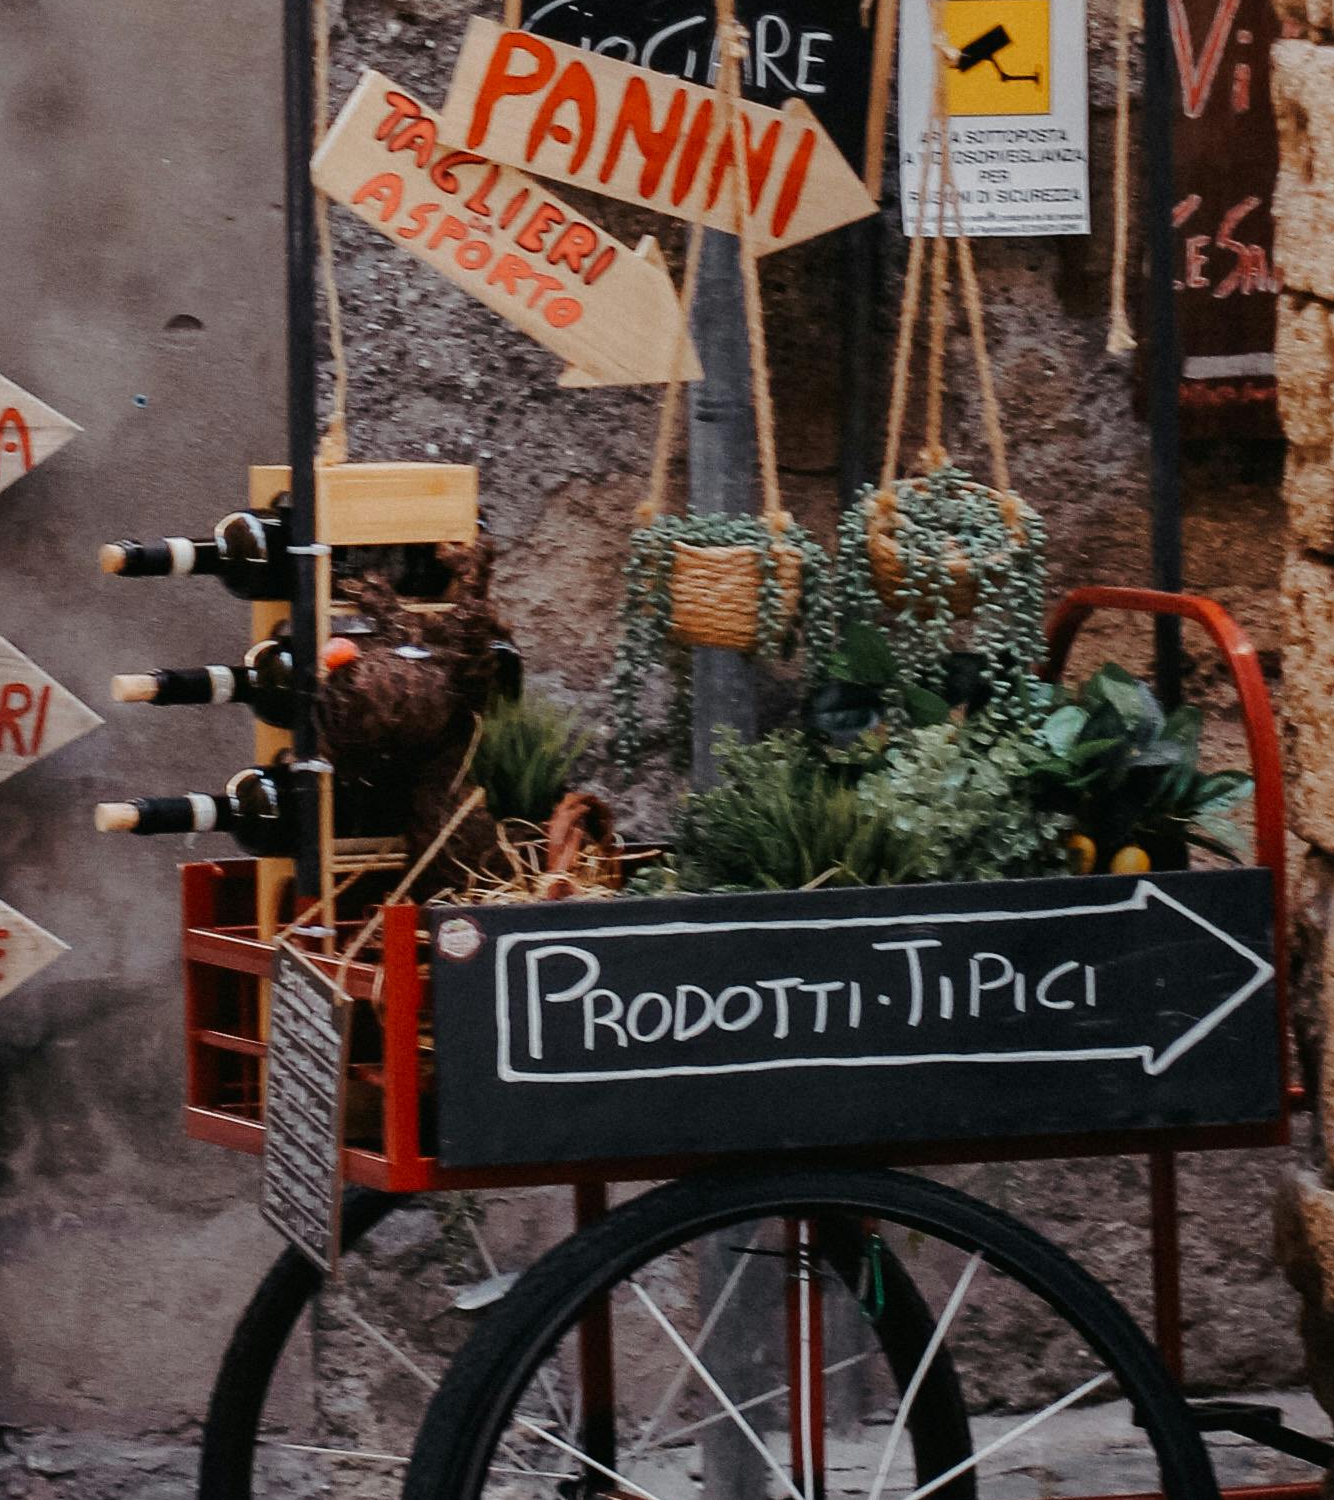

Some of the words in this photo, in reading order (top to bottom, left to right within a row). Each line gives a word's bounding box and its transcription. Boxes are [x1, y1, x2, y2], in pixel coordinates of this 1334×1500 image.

[374, 90, 619, 287] TAGLIERI
[465, 30, 817, 240] PANINI
[351, 172, 584, 329] ASPORTO
[526, 944, 862, 1060] PRODOTTI
[872, 939, 1098, 1027] TIPICI
